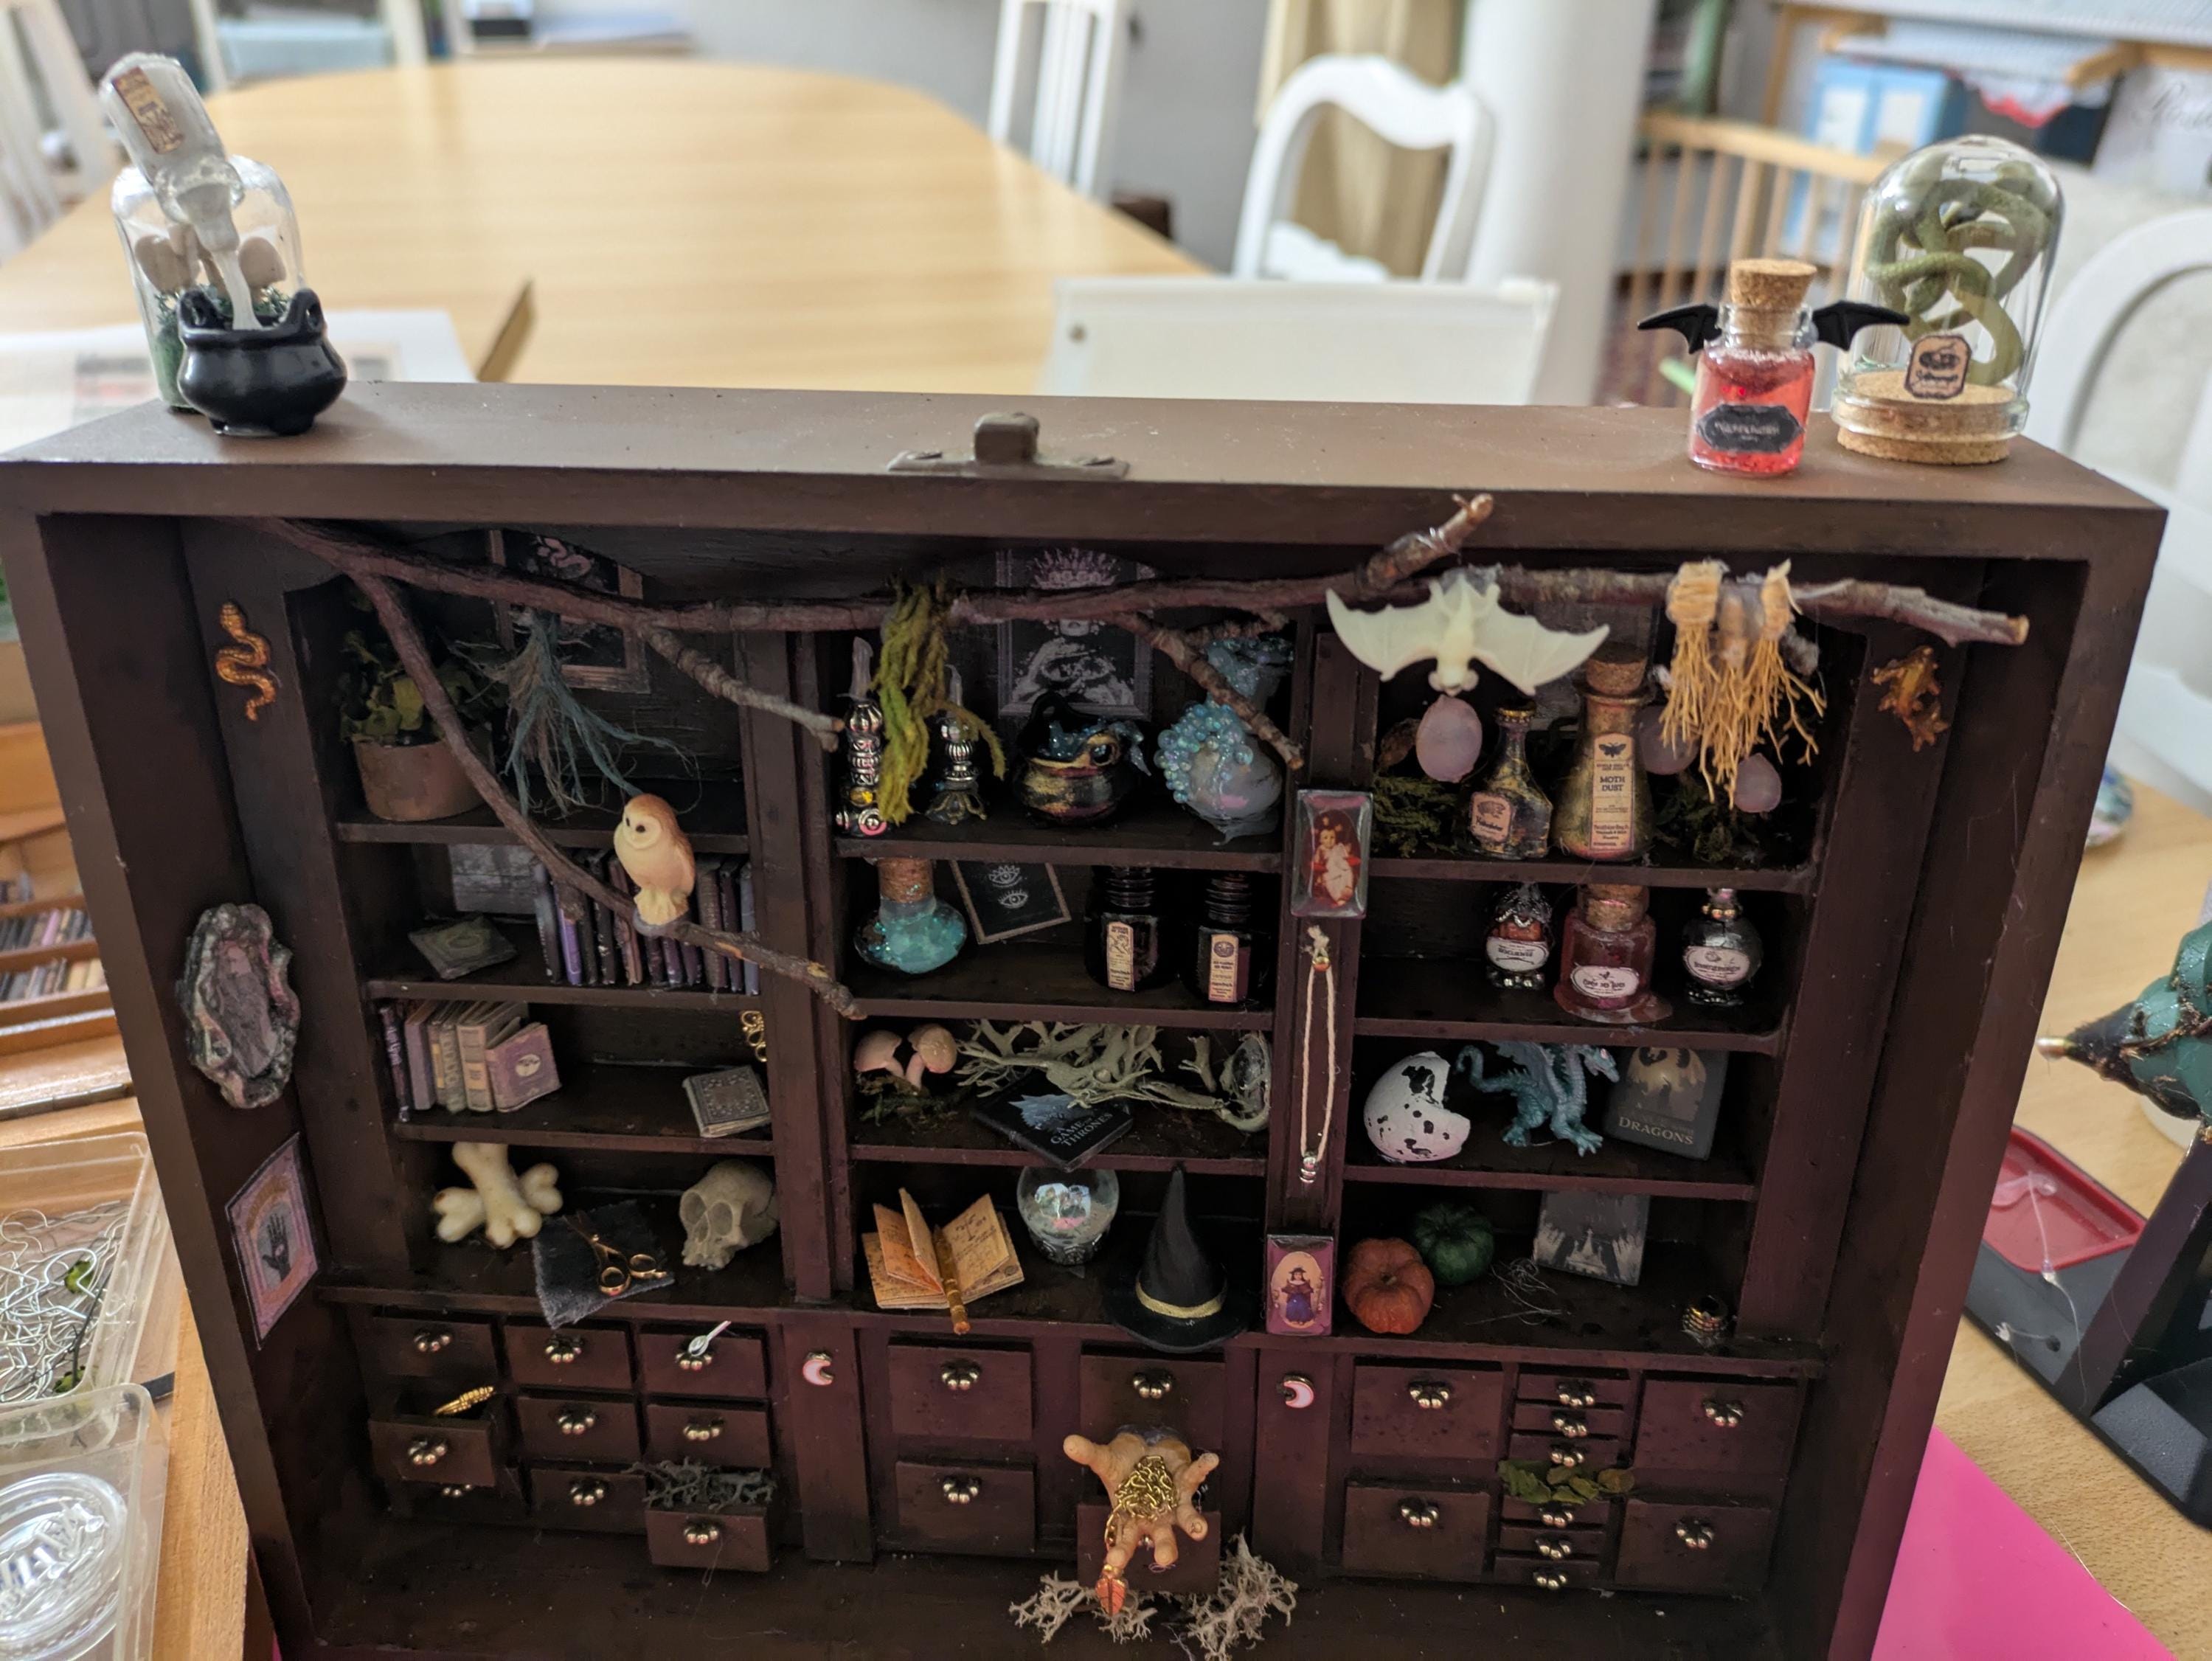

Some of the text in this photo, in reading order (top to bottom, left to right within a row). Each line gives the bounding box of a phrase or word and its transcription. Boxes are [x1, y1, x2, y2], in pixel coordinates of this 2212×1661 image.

[1599, 775, 1626, 783] MOTH
[1601, 784, 1624, 792] DUST
[1050, 1121, 1082, 1144] GAME
[1061, 1112, 1113, 1146] THRONES
[1619, 1117, 1693, 1145] DRAGONS
